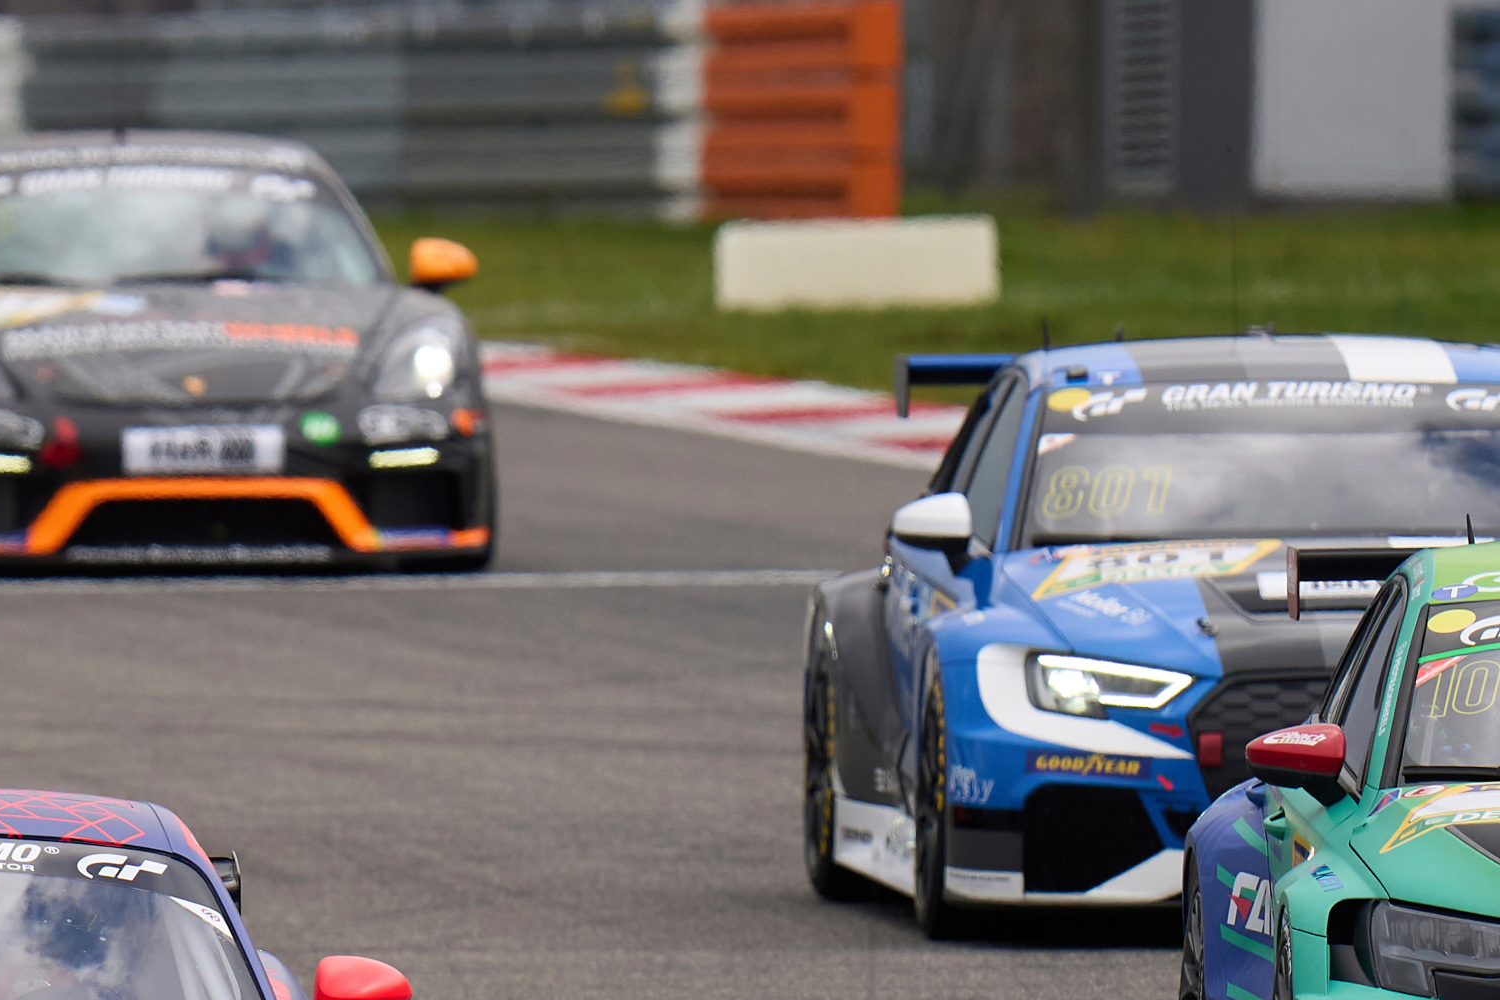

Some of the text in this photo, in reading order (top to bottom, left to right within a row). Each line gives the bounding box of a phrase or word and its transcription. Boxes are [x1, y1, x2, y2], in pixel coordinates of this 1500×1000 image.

[1161, 380, 1418, 401] GRAN TURISMO
[1042, 464, 1174, 519] 801
